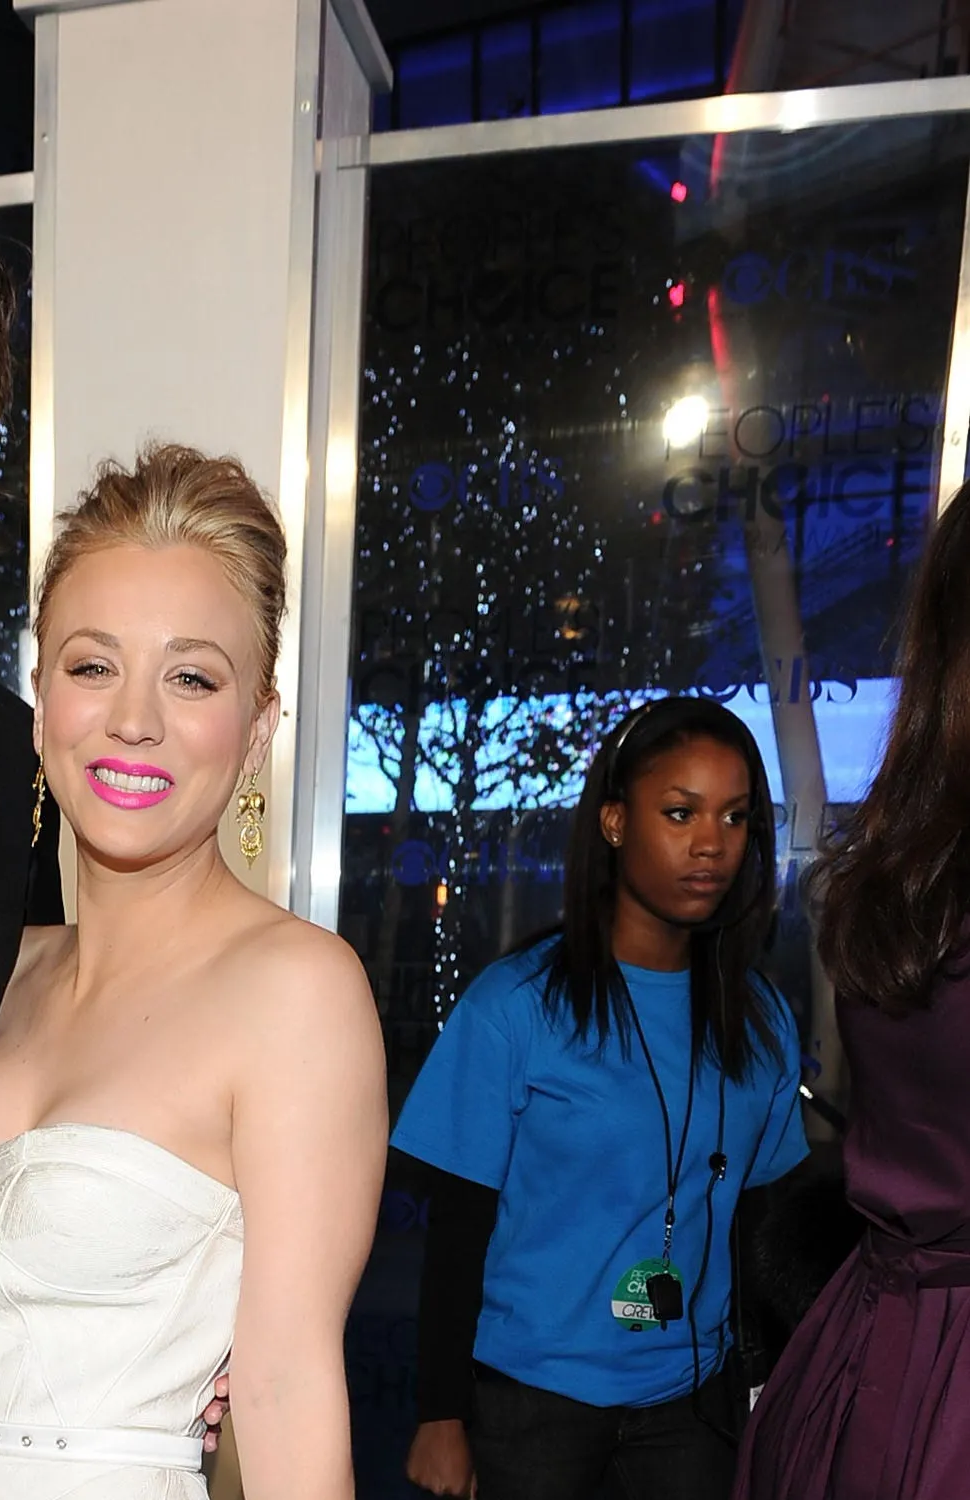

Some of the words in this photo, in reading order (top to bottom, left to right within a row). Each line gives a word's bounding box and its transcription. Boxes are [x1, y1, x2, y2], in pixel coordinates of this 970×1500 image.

[667, 396, 932, 461] EOPLE'S
[662, 458, 927, 522] CHOICE
[622, 1303, 656, 1319] CRE
